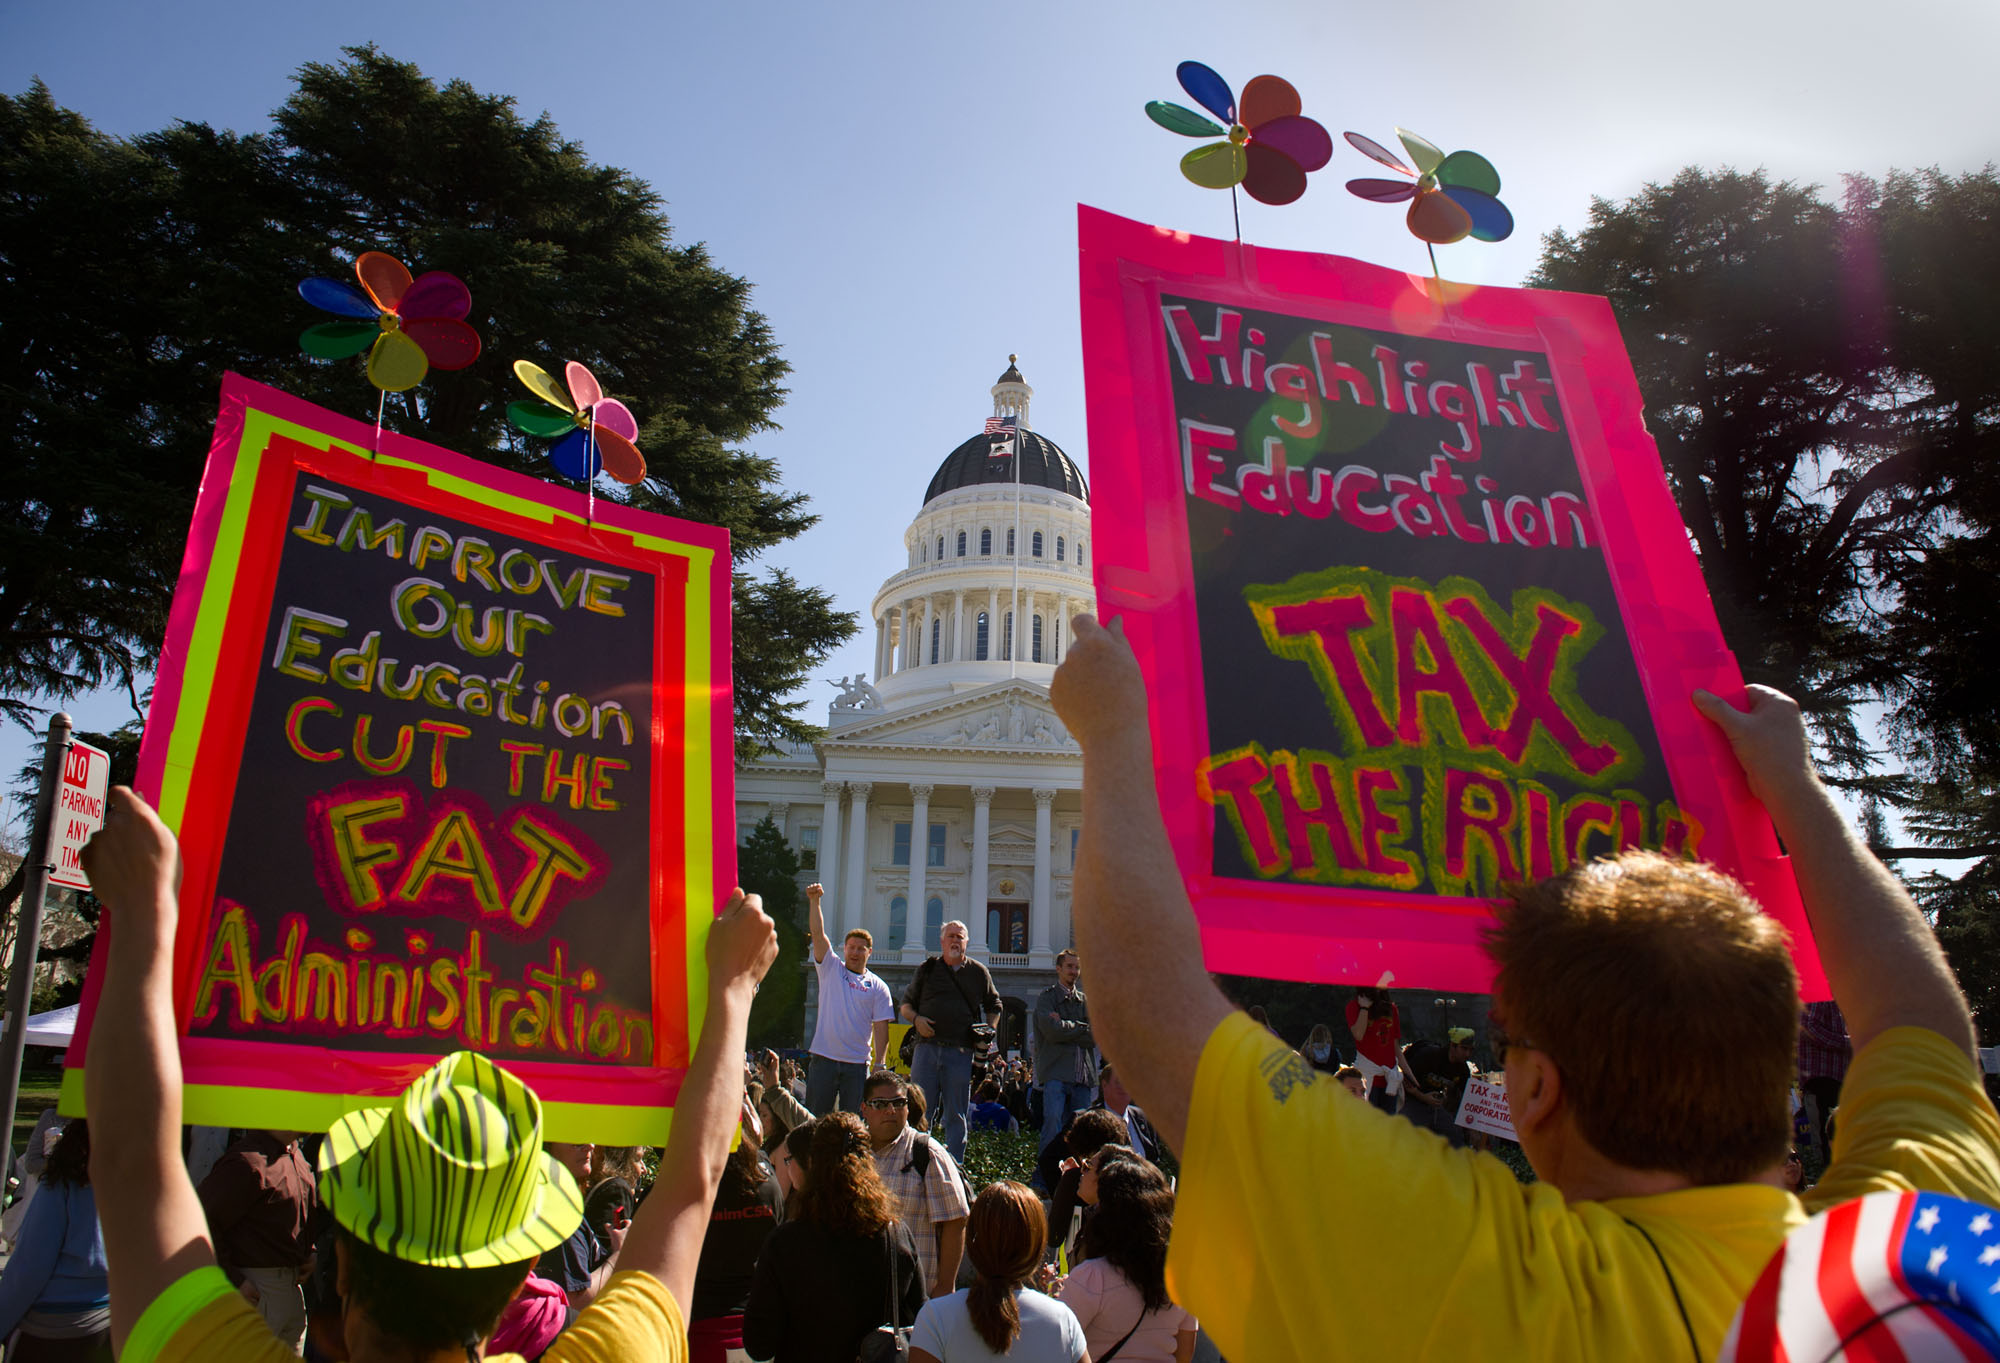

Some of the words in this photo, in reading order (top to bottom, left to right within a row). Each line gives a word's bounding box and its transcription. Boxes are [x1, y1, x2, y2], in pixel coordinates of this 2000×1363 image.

[1161, 305, 1560, 463] Highlight
[1180, 417, 1600, 550] Education
[292, 484, 631, 617] IMPROVE
[273, 606, 634, 746] Education
[390, 577, 556, 658] Our
[1246, 584, 1636, 786] TAX
[60, 788, 102, 819] PARKING
[66, 752, 87, 782] NO
[284, 695, 472, 788] CUT
[500, 738, 632, 811] THE
[1198, 742, 1422, 889] THE
[66, 818, 90, 843] ANY
[325, 792, 596, 930] FAT
[194, 905, 654, 1064] Administration
[1464, 1103, 1511, 1123] CORPORATIO
[1470, 1084, 1489, 1097] TAX
